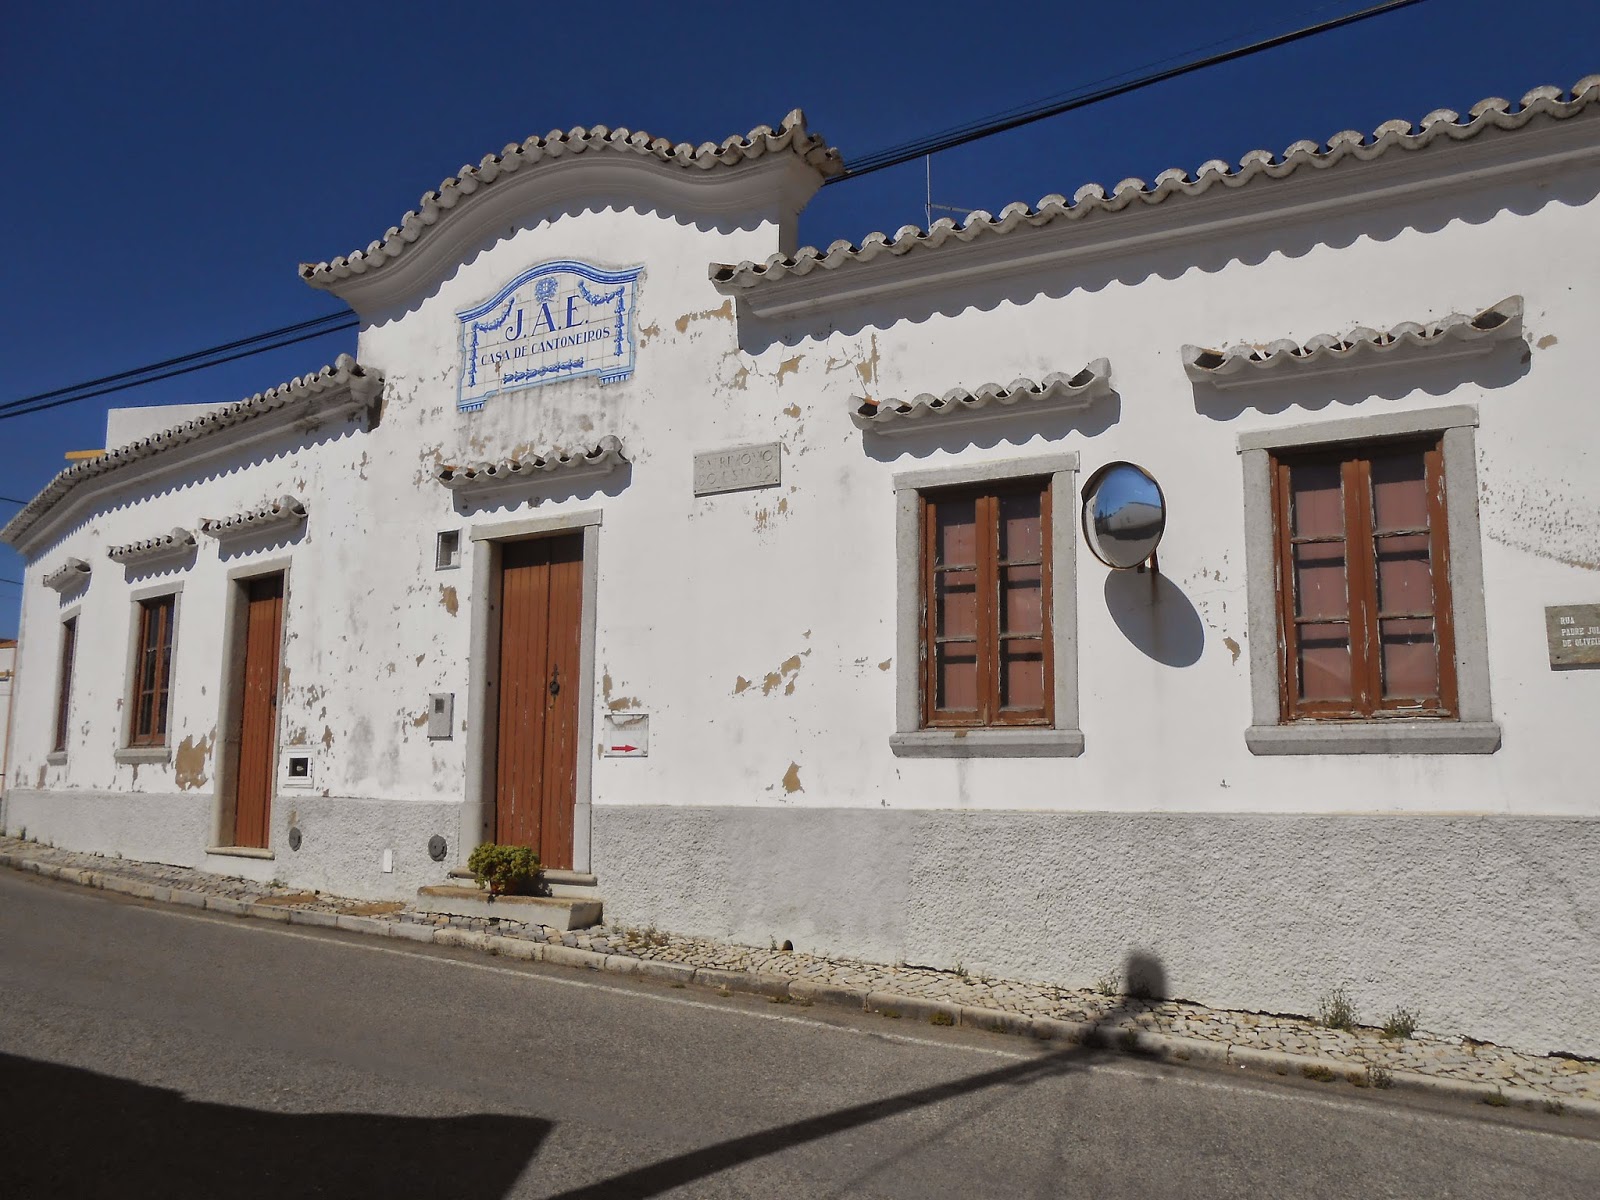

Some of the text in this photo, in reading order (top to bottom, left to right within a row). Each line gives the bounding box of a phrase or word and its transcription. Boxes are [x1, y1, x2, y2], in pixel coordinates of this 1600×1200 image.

[481, 327, 610, 366] CASA DE CANTONEIROS
[1560, 616, 1575, 625] RUA
[1561, 627, 1584, 636] PADRE
[1562, 639, 1572, 648] DE
